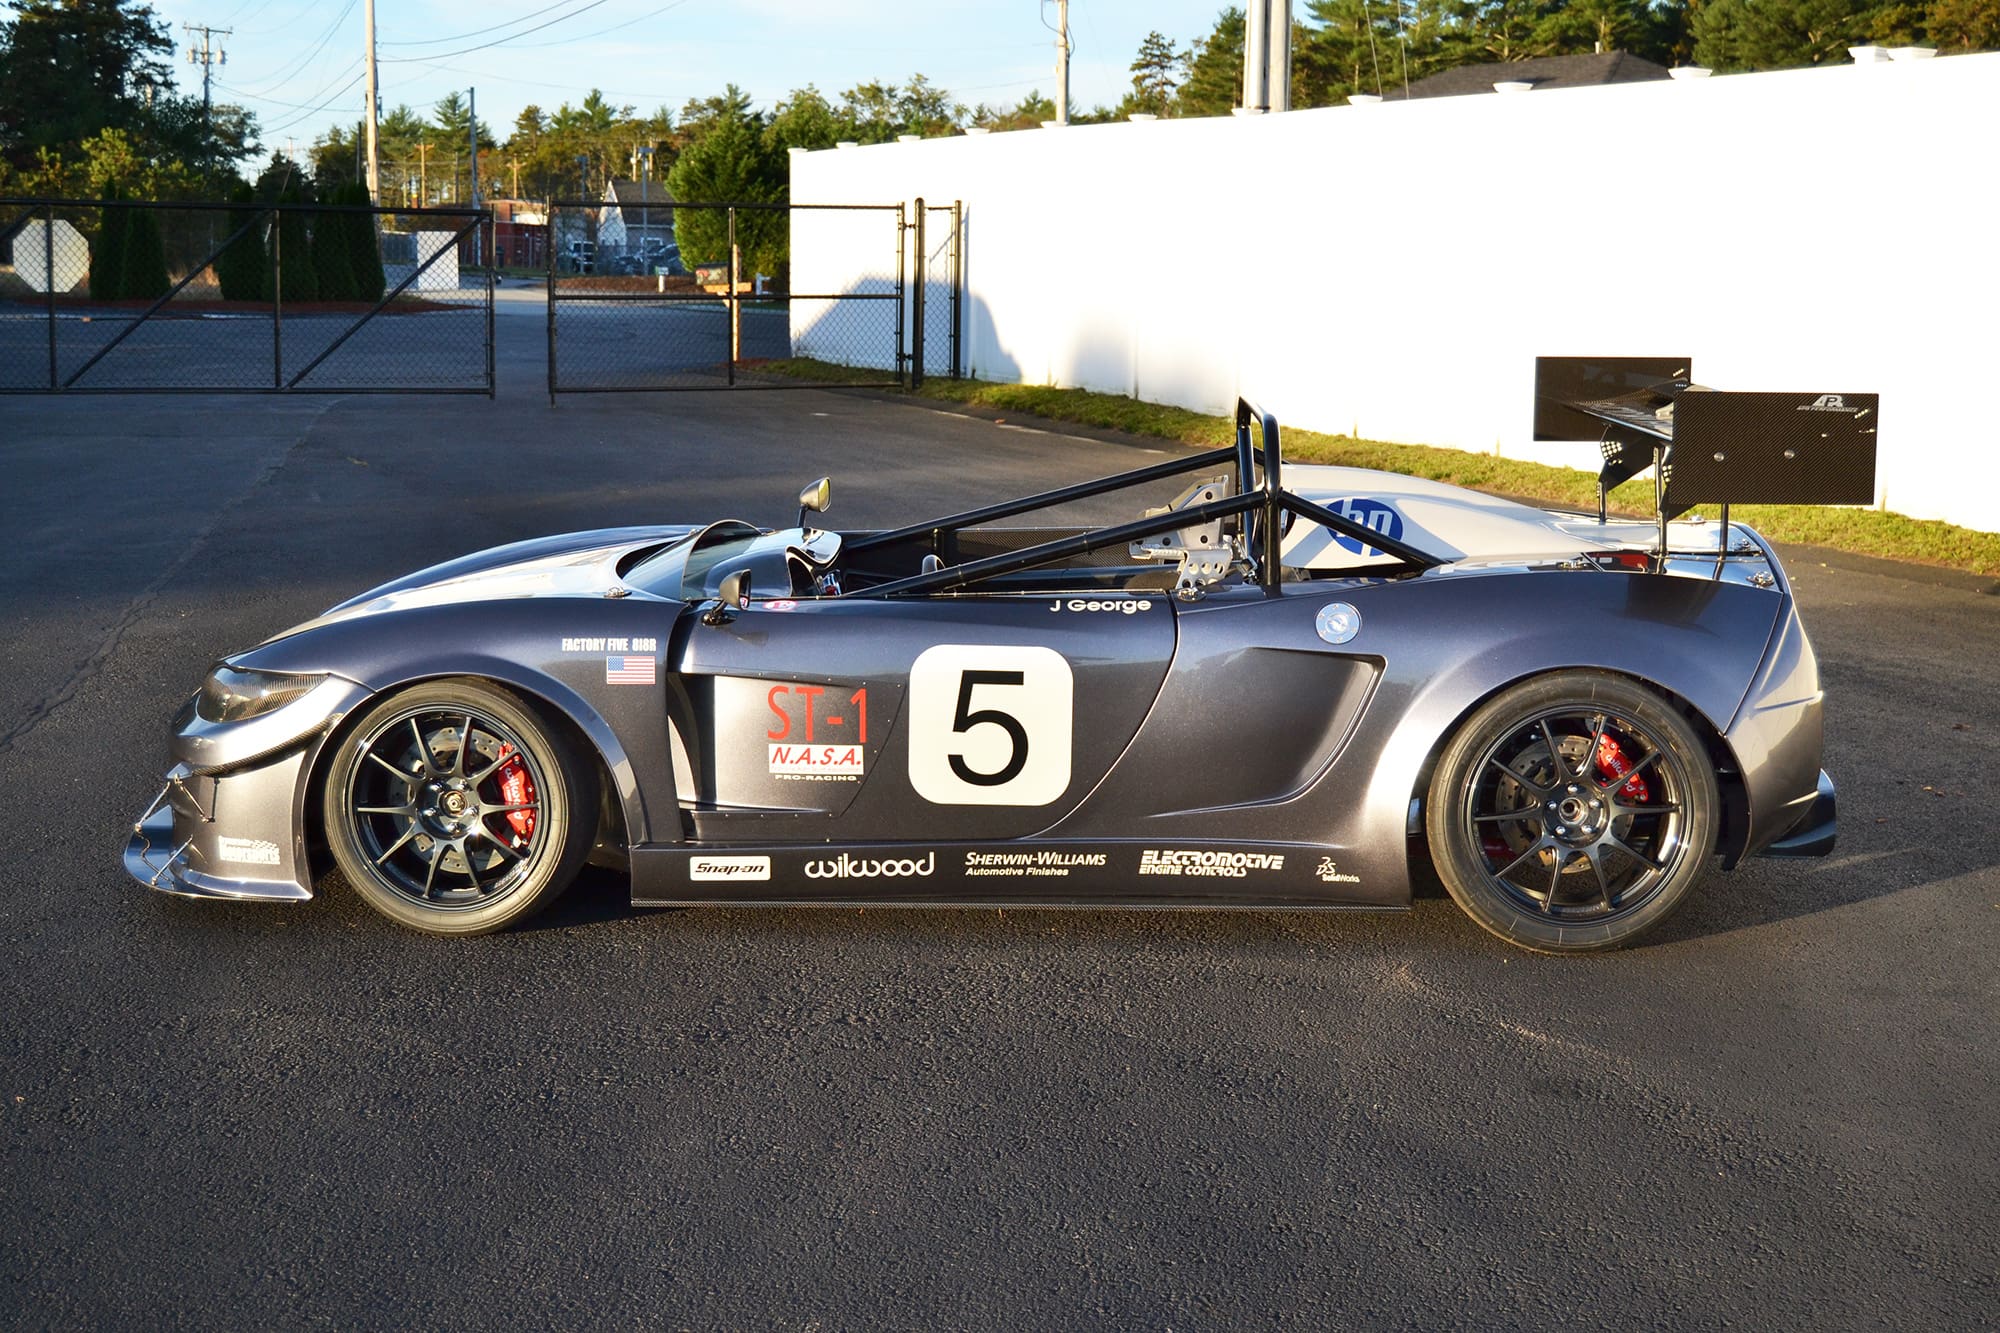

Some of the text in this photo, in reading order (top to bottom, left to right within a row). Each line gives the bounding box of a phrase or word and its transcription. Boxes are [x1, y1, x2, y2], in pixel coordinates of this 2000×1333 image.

[1050, 600, 1152, 614] J George
[562, 638, 657, 652] FACTORY FIVE 818R
[767, 685, 867, 743] ST-1
[947, 670, 1029, 787] 5
[772, 746, 862, 766] N.A.S.A.
[804, 851, 935, 878] wilwood
[965, 851, 1107, 866] SHERWIN-WILLIAMS
[1141, 850, 1285, 870] ELECTROMOTIVE
[695, 863, 765, 875] Snap-on
[965, 867, 1069, 876] Automotive Finishes
[1139, 864, 1247, 877] ENGINE CONTROLS
